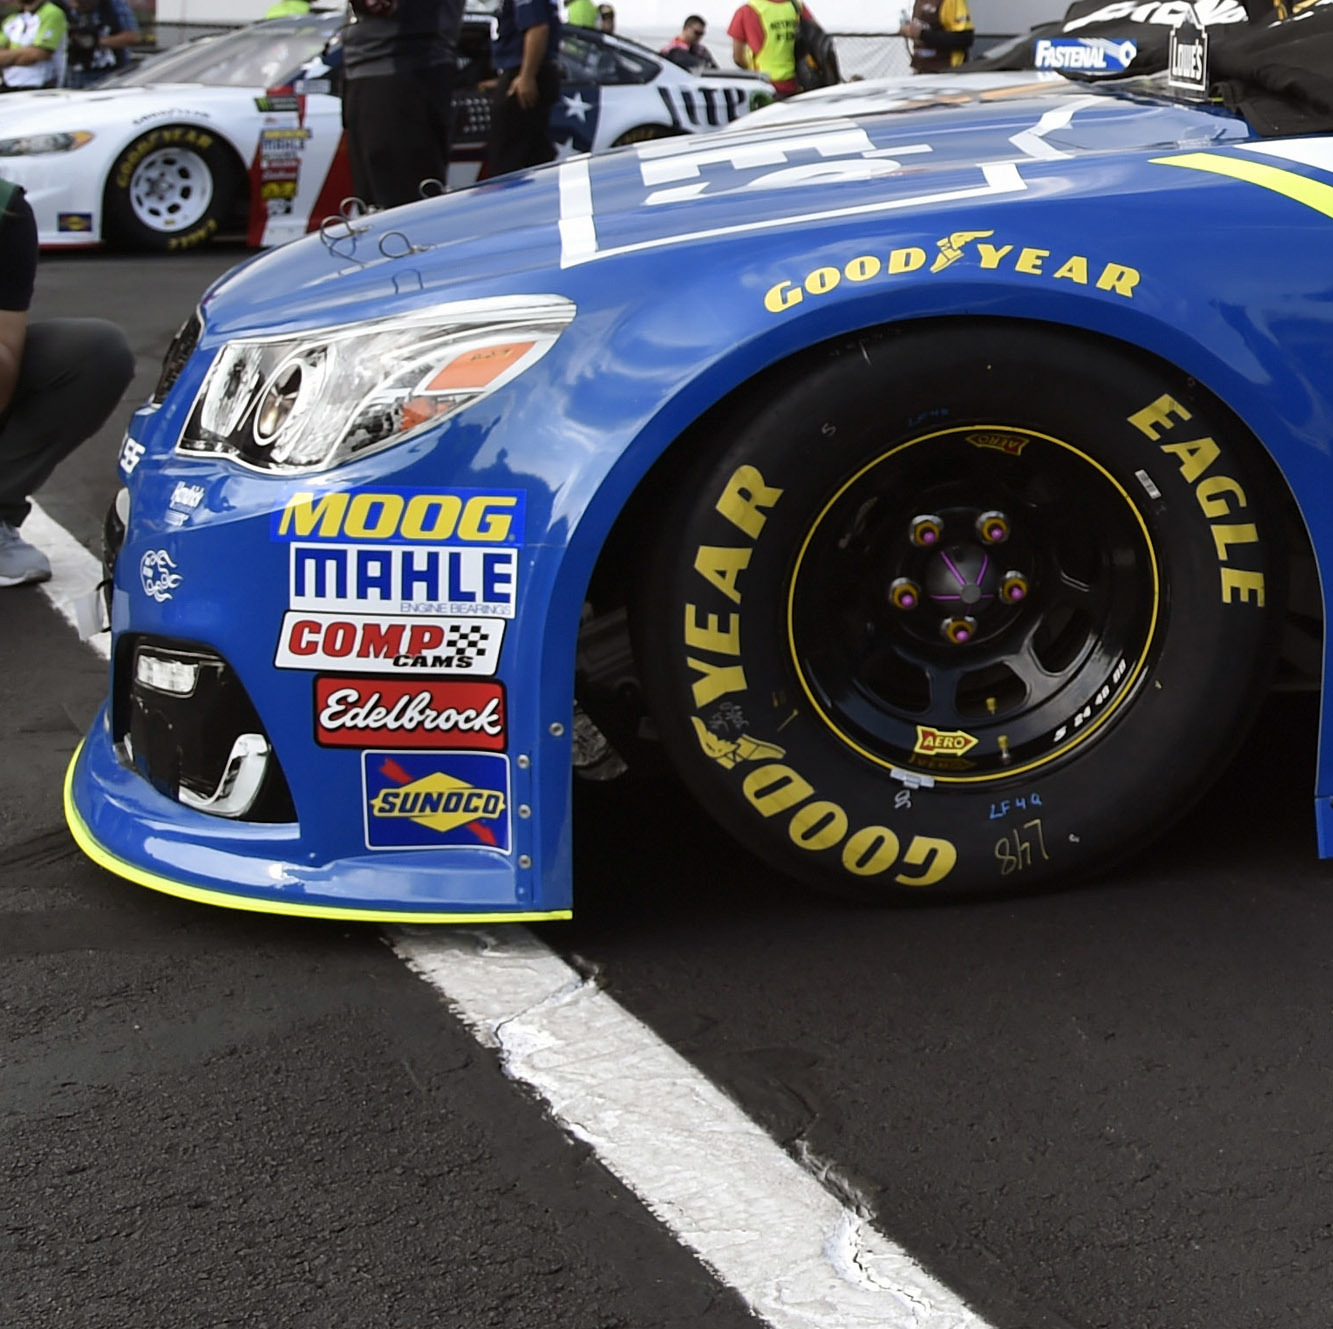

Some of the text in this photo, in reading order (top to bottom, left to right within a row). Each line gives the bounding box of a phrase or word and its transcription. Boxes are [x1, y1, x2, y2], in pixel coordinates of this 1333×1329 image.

[1035, 39, 1107, 69] FASTENAL
[764, 237, 1141, 313] GOODYEAR
[278, 492, 518, 542] MOOG
[1126, 392, 1266, 608] EAGLE
[294, 547, 513, 604] MAHLE
[399, 602, 512, 616] ENGINE BEARINGS
[288, 619, 445, 660] COMP
[392, 654, 474, 669] CAMS
[684, 464, 957, 887] GOODYEAR
[318, 687, 503, 736] Edelbrock
[922, 734, 966, 749] AERO
[377, 791, 501, 815] SUNOCO
